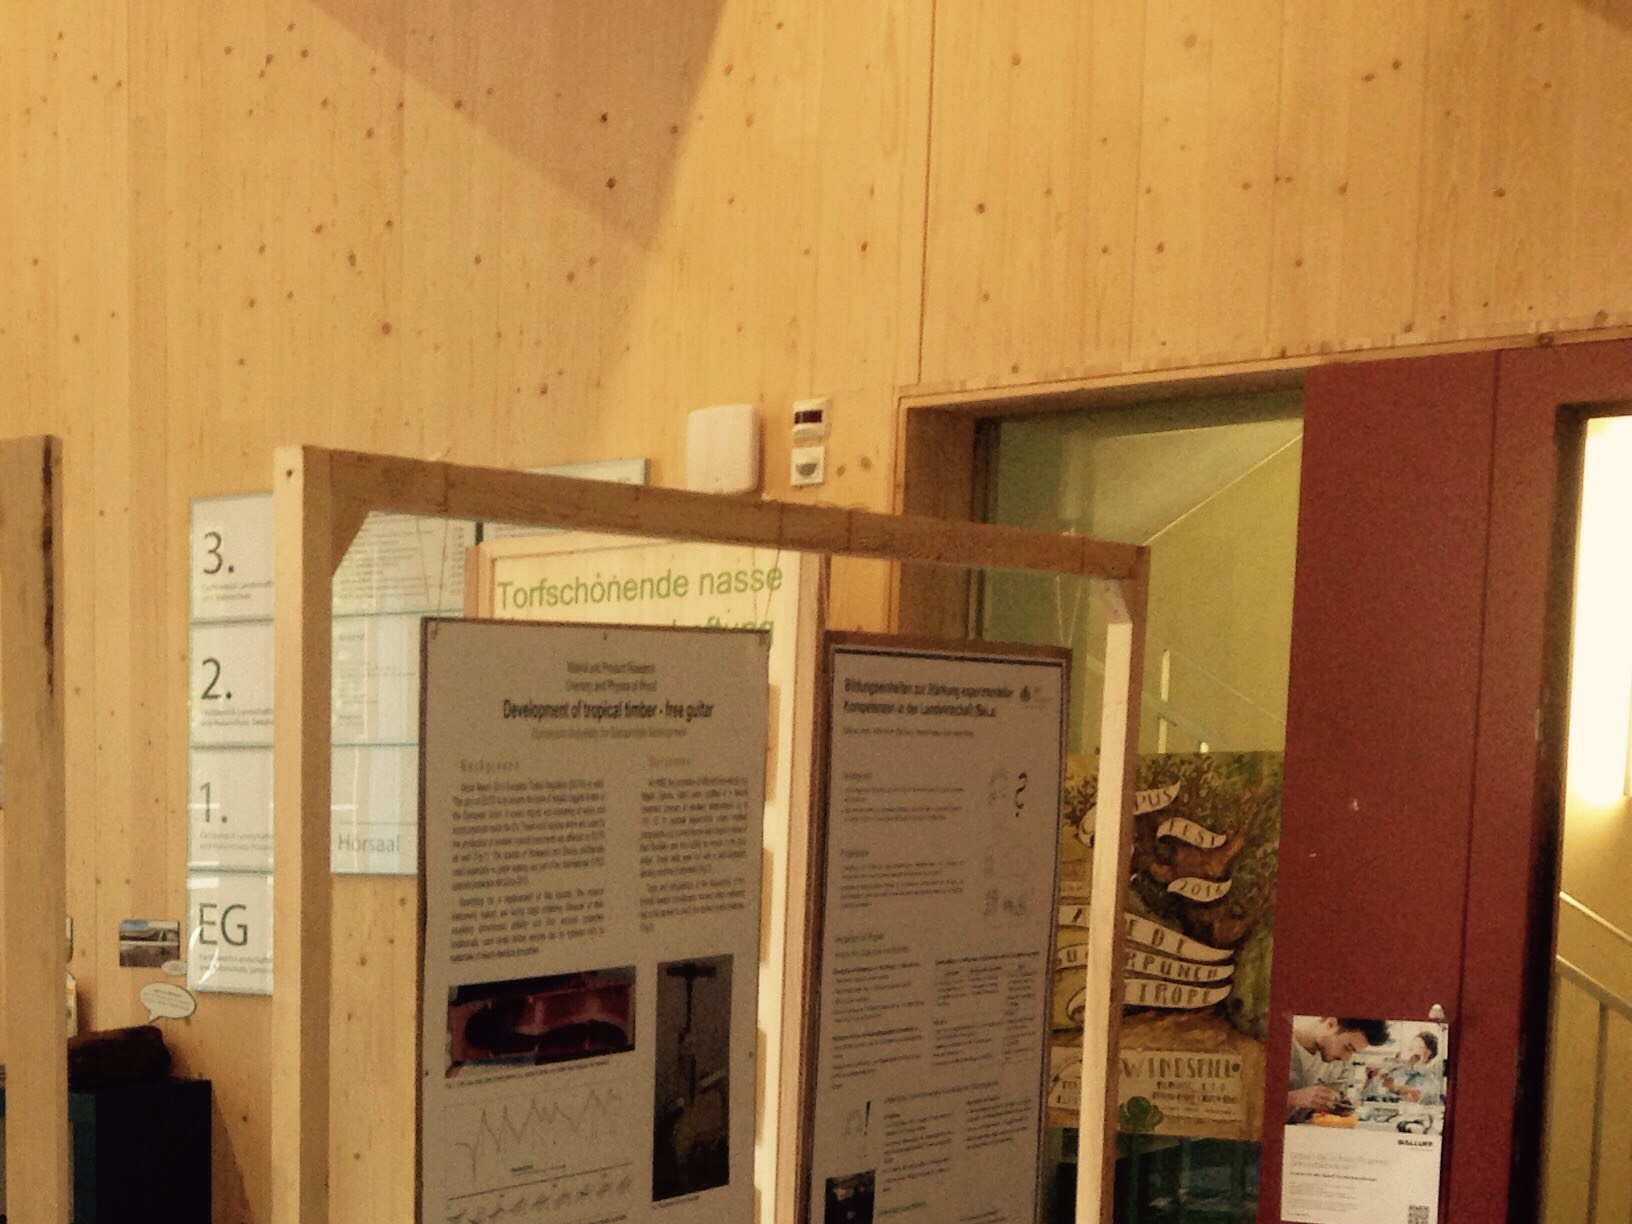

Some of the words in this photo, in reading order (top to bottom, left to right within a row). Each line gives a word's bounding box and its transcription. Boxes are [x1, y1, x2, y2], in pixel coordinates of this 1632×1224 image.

[203, 531, 235, 575] 3.
[699, 565, 783, 594] nasse
[201, 658, 233, 702] 2.
[502, 699, 569, 722] Development
[571, 700, 582, 719] of
[583, 701, 622, 722] tropical
[624, 700, 657, 719] timber
[665, 700, 684, 719] free
[686, 700, 714, 722] guitar
[199, 782, 228, 824] 1.
[199, 902, 248, 946] EG
